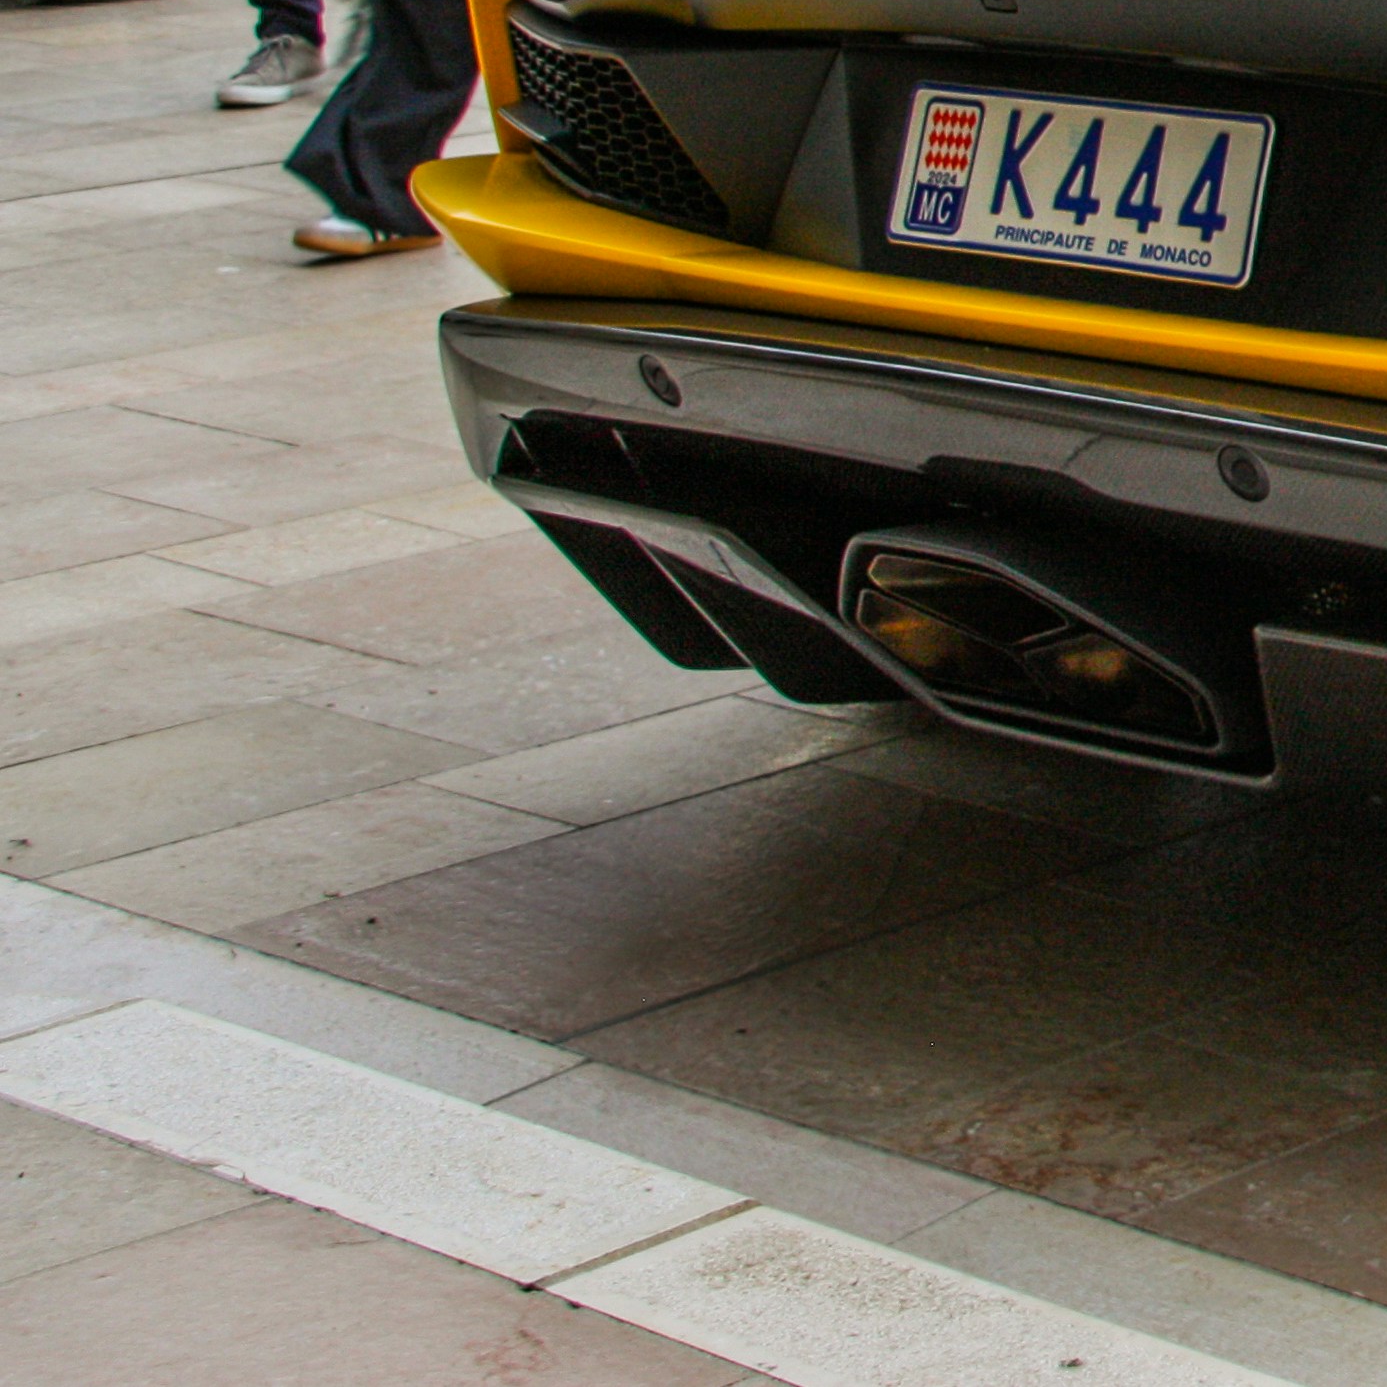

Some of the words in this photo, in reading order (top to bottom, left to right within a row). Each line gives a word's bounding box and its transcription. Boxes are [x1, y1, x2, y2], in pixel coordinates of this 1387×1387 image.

[926, 170, 958, 185] 2024
[989, 108, 1232, 244] K444
[917, 188, 954, 224] MC
[994, 224, 1096, 252] PRINCIPAUTE
[1106, 238, 1129, 256] DE
[1139, 242, 1213, 268] MONACO
